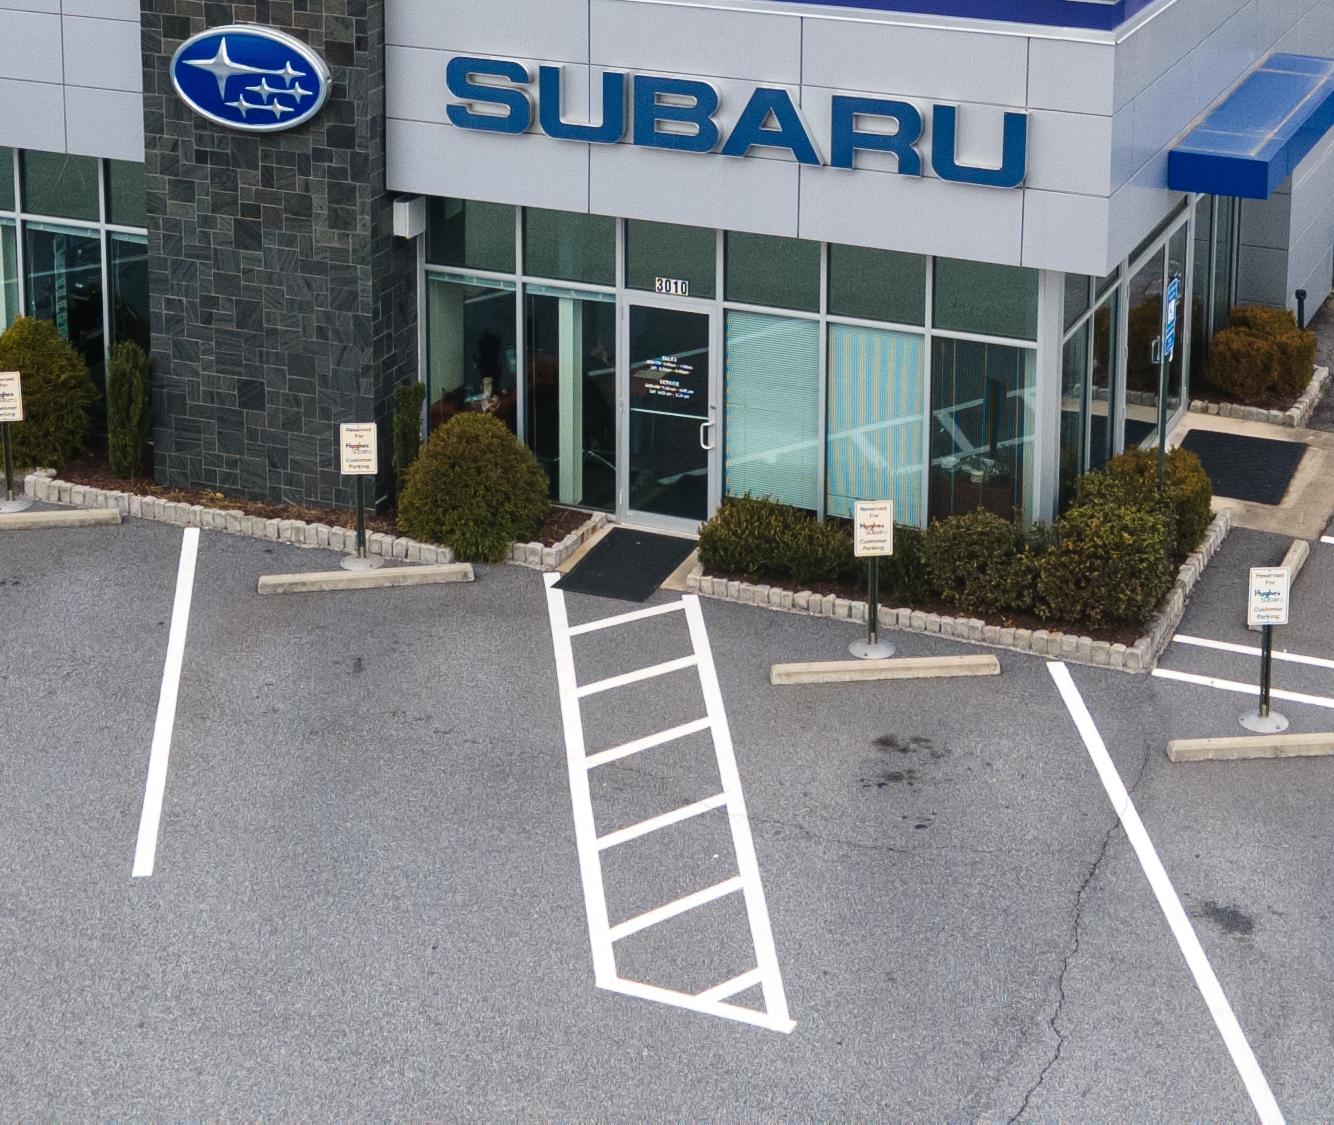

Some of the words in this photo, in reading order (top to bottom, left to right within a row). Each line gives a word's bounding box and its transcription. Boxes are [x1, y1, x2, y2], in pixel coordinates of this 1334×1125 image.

[445, 55, 1030, 189] SUBARU
[656, 277, 688, 295] 3010
[345, 442, 370, 451] Hughes
[859, 522, 885, 531] Hughes
[1254, 589, 1281, 599] Hughes
